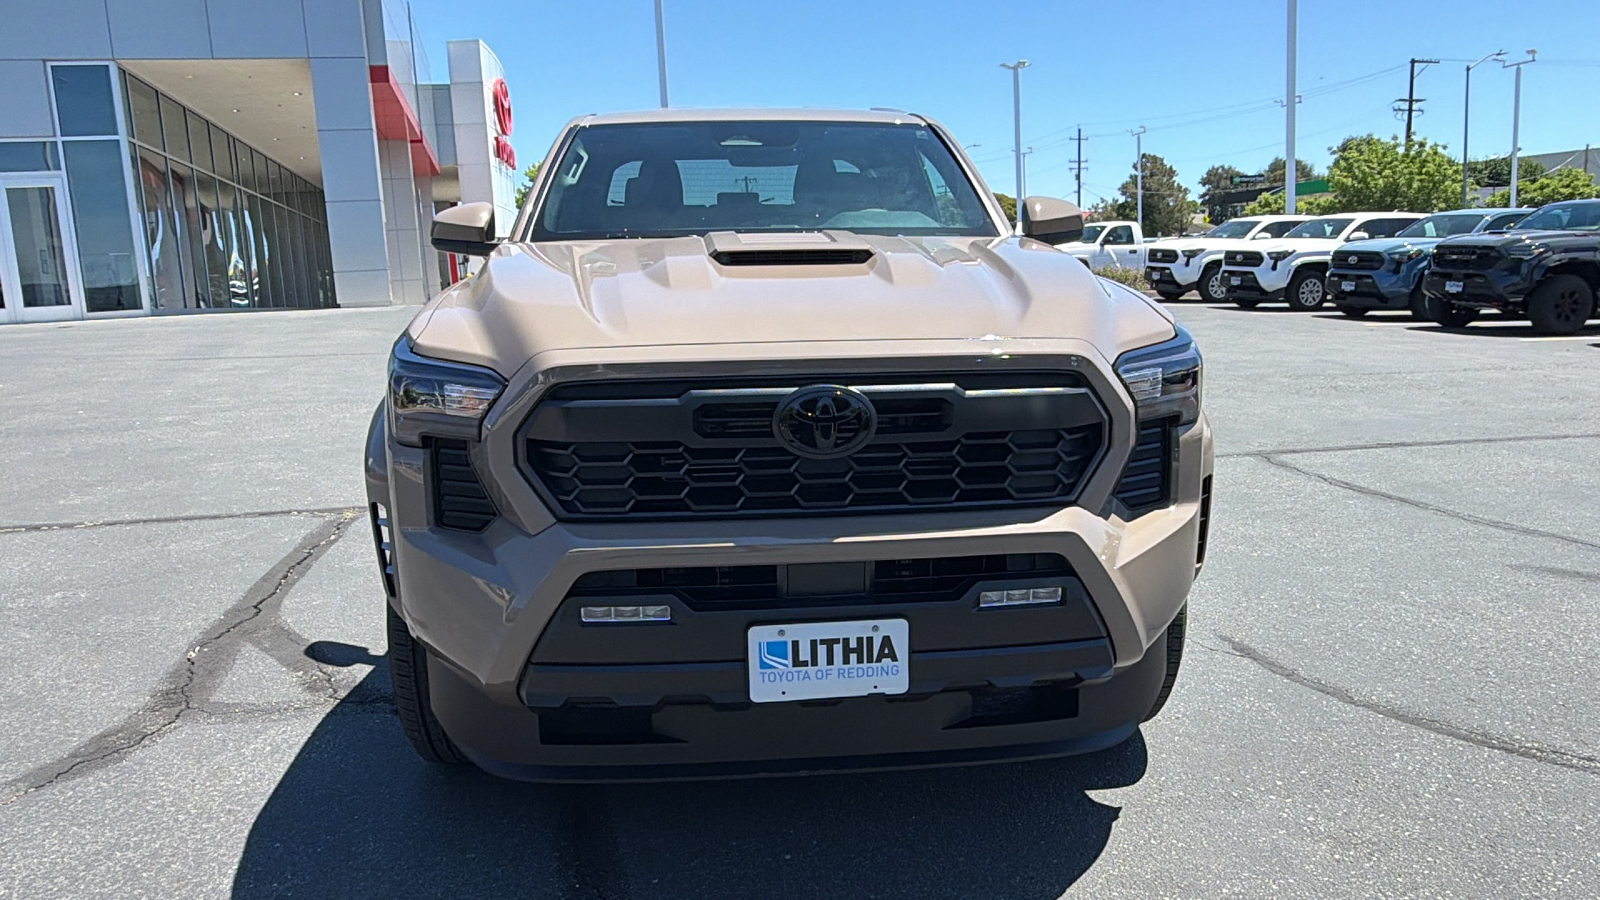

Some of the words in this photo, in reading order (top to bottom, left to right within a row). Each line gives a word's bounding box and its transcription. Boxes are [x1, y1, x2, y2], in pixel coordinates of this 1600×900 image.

[792, 635, 898, 667] LITHIA
[759, 670, 811, 683] TOYOTA
[815, 668, 833, 680] OF
[837, 665, 900, 679] REDDING
